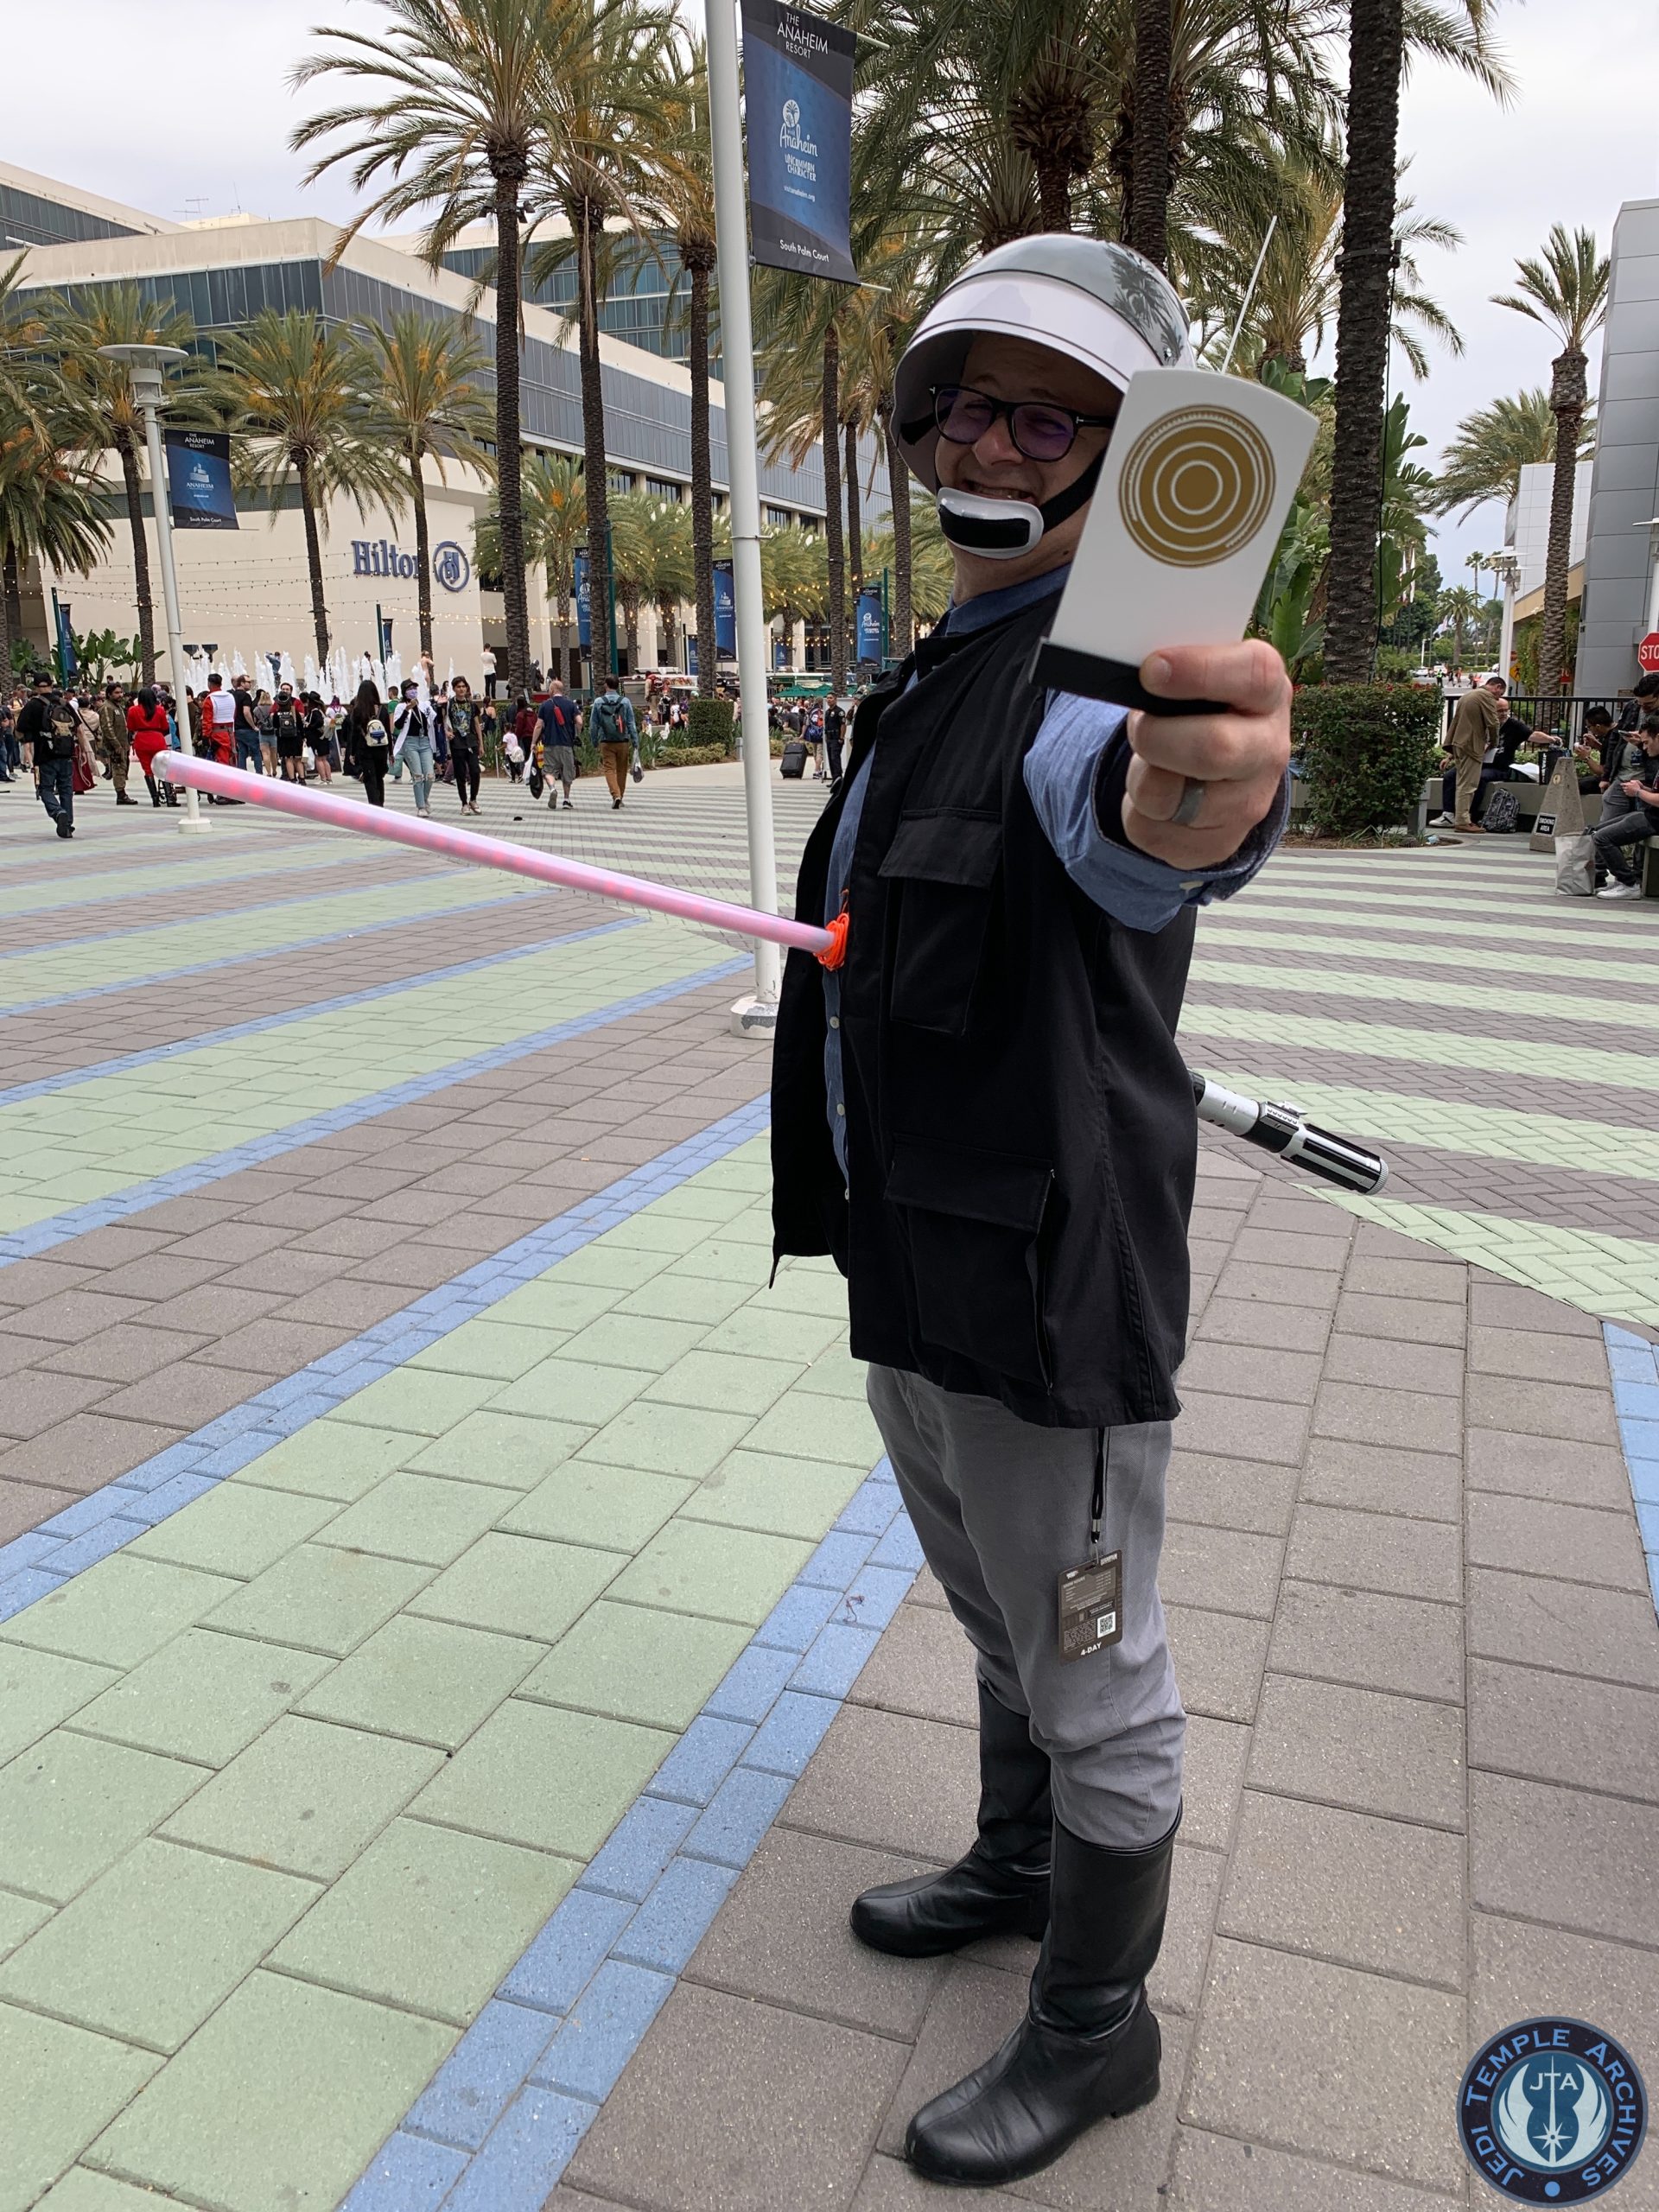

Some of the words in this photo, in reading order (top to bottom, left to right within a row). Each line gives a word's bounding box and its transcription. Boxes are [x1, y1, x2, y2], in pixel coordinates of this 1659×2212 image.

[786, 12, 800, 26] THE
[777, 22, 829, 54] ANAHEIM
[785, 41, 811, 59] RESORT
[779, 123, 818, 156] Anaheim
[787, 164, 817, 181] CHARACTER
[779, 238, 797, 253] South
[798, 245, 812, 257] Palm
[812, 249, 830, 263] Court
[184, 436, 215, 445] ANAHEIM
[1080, 1642, 1102, 1656] 4-DAY
